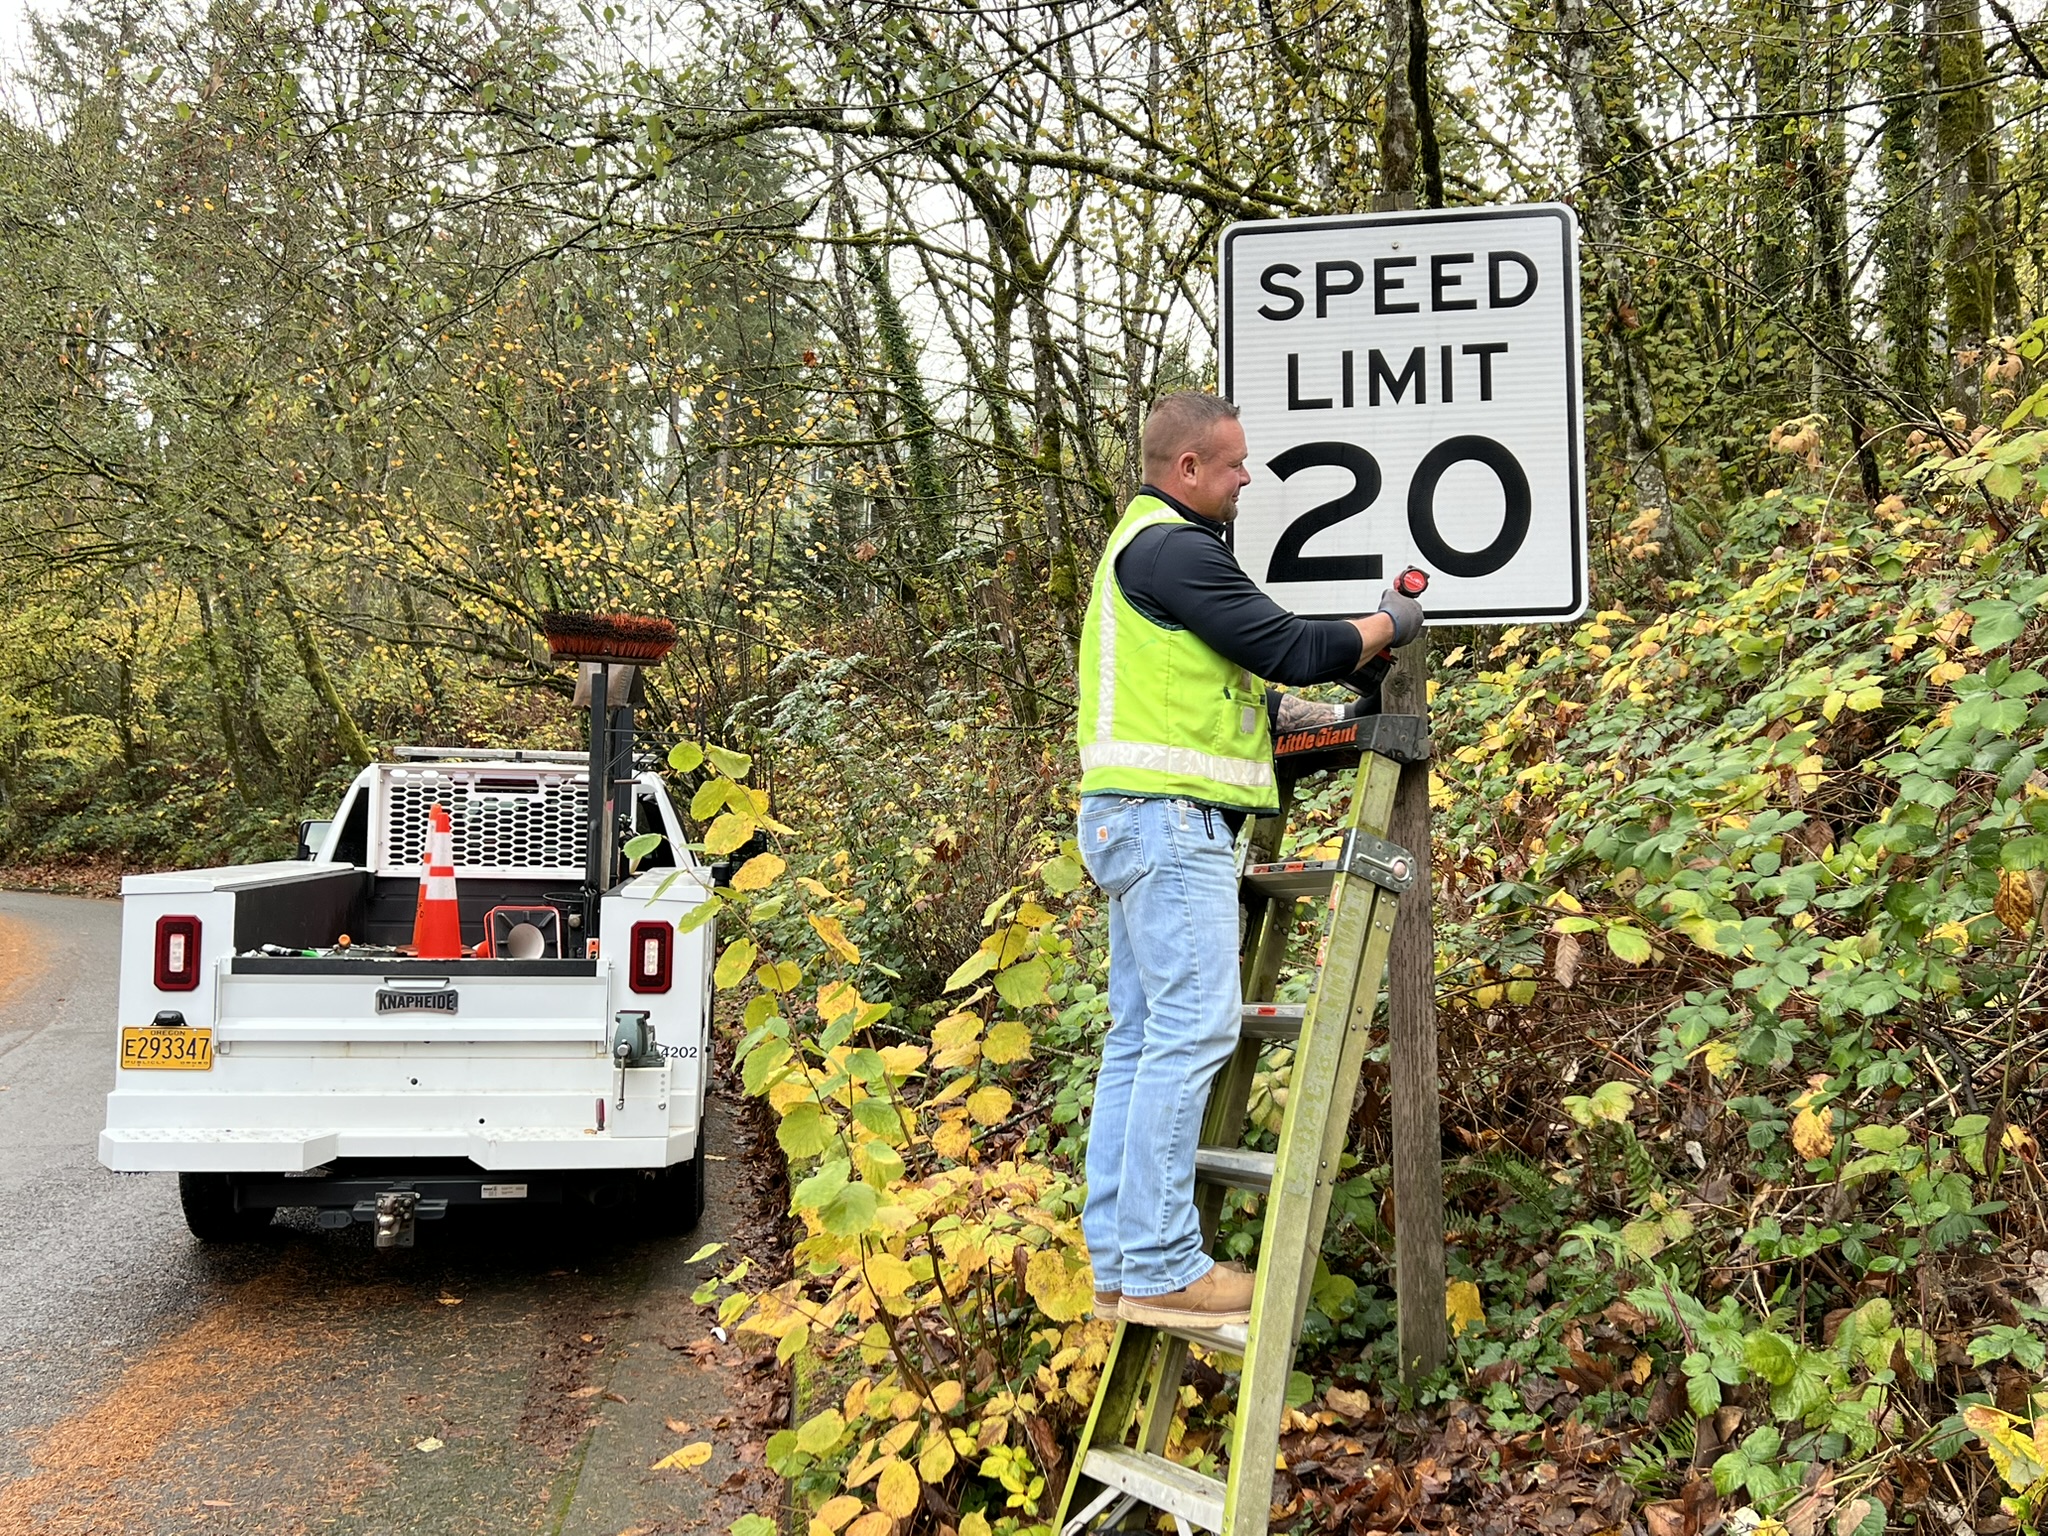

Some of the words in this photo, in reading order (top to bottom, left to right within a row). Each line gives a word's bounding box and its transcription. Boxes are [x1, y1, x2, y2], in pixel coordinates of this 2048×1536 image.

[1257, 250, 1538, 321] SPEED
[1287, 342, 1508, 411] LIMIT
[1266, 435, 1531, 583] 20
[378, 993, 455, 1011] KNAPHEIDE
[125, 1036, 210, 1059] E293347
[661, 1046, 697, 1058] 4202
